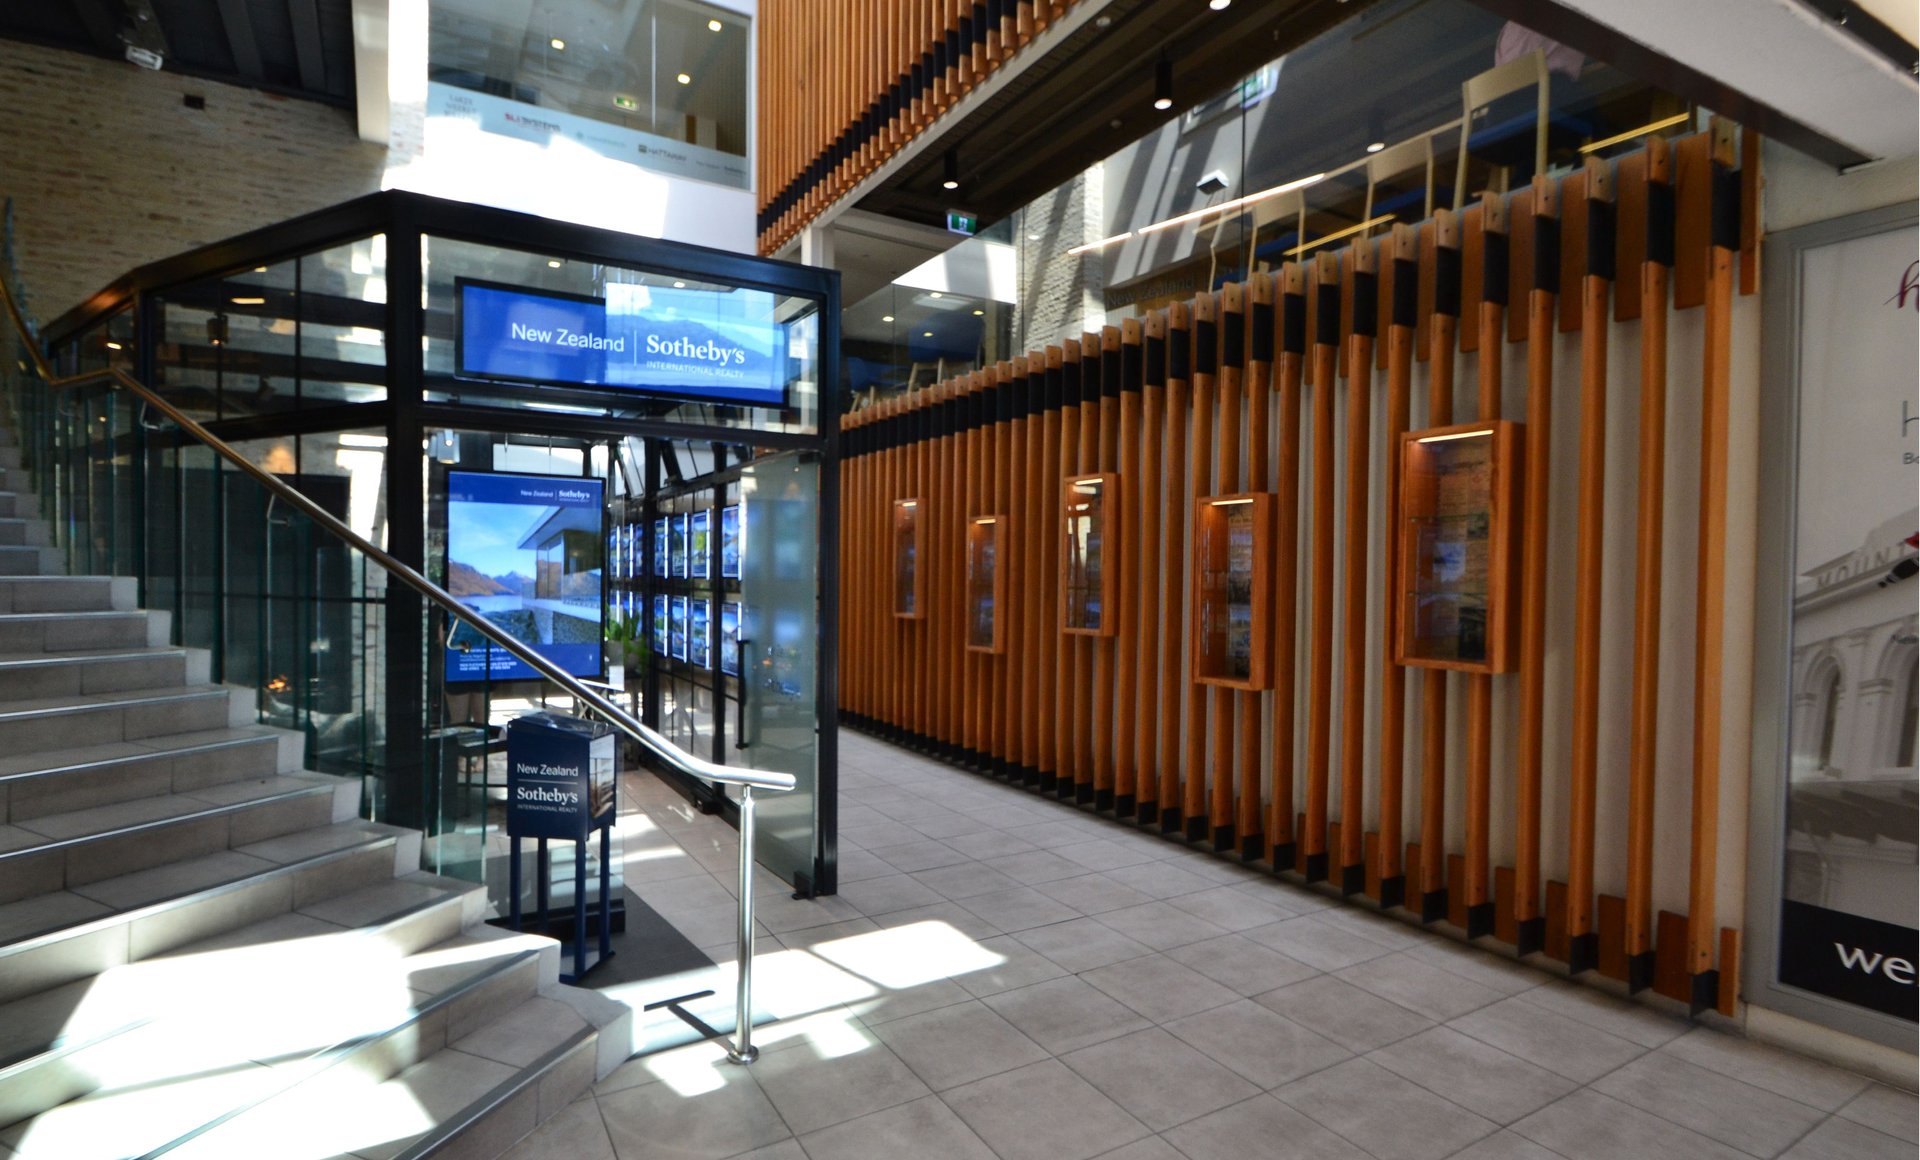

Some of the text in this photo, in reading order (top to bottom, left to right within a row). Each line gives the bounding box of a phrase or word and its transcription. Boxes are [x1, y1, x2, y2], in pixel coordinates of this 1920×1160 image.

[512, 322, 746, 366] New Zealand Sotheby's
[646, 360, 745, 379] INTERNATIONAL REALTY
[559, 489, 590, 501] Sotheby's
[517, 763, 579, 776] New Zealand
[516, 786, 578, 806] Sotheby's
[516, 803, 558, 812] INTERNATIONAL
